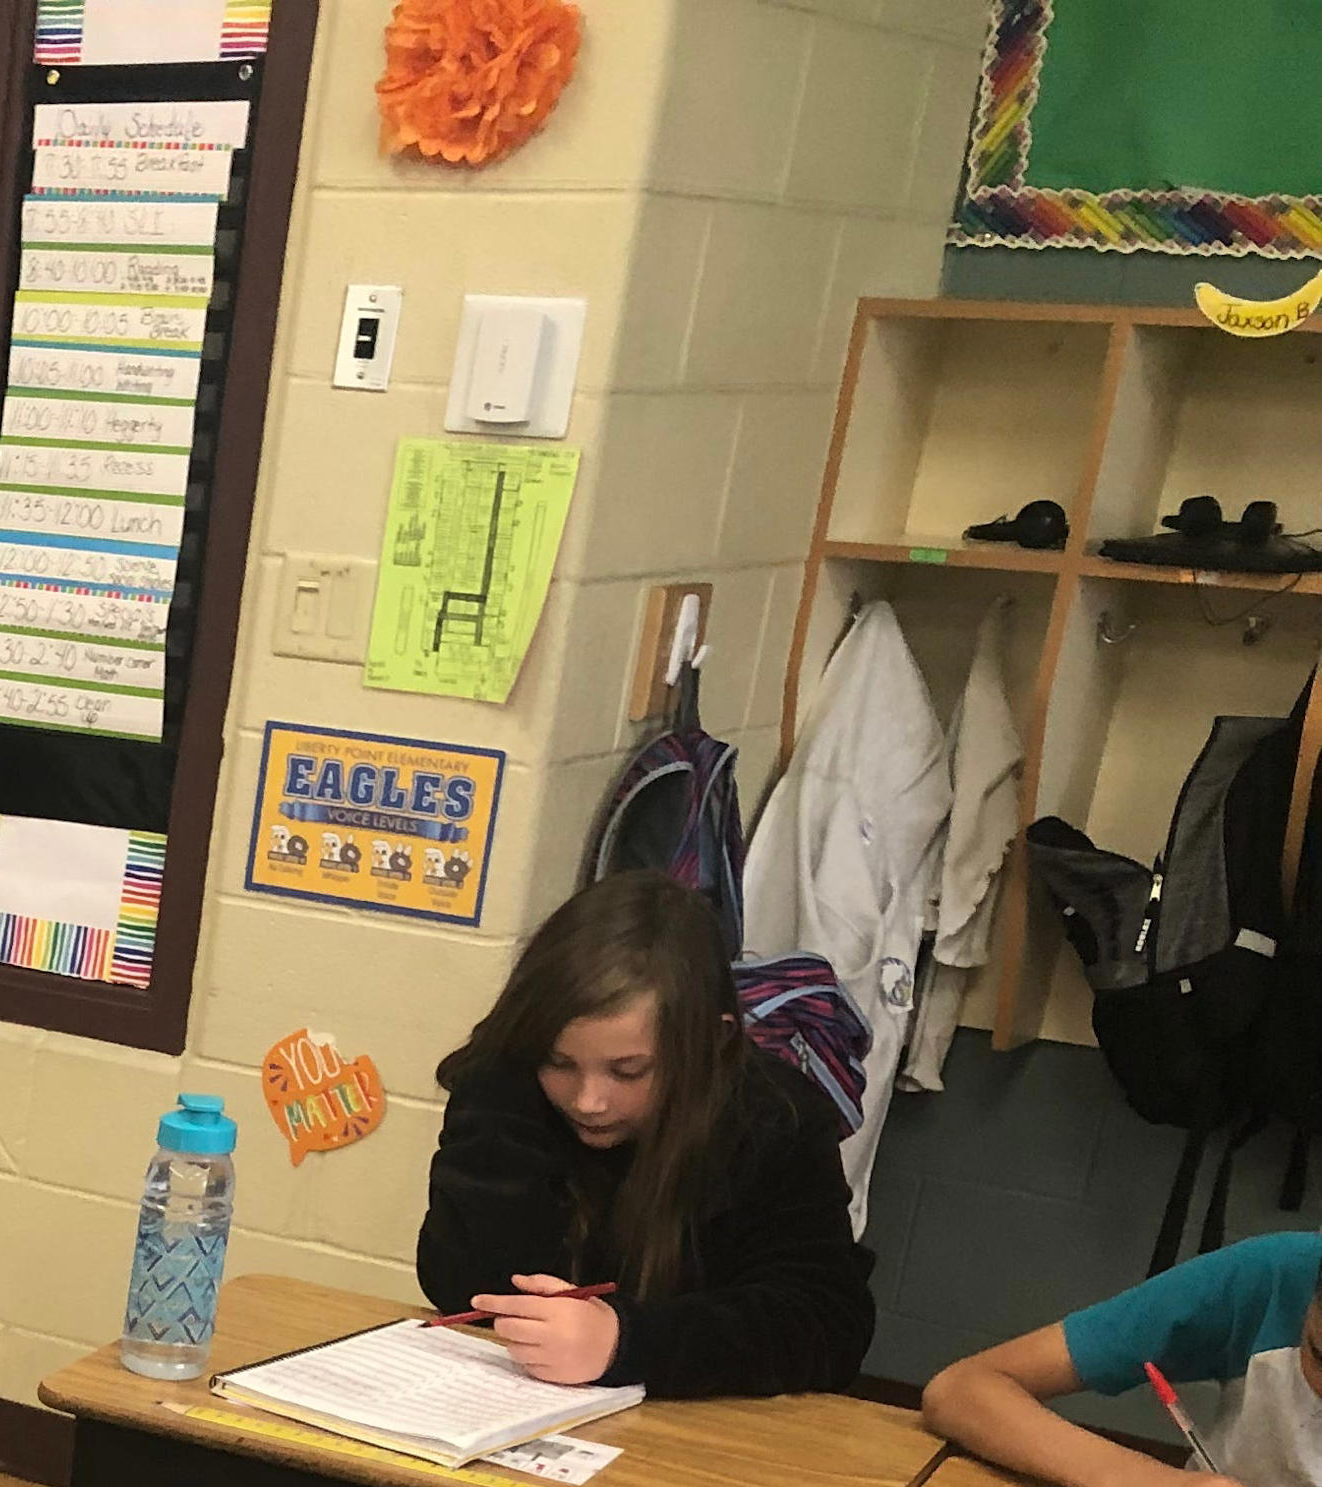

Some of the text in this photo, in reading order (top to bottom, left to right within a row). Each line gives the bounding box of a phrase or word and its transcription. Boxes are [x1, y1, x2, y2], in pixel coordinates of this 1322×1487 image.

[1297, 301, 1310, 321] B
[111, 506, 164, 537] Lunch
[345, 746, 385, 763] POINT
[386, 750, 470, 774] ELEMENTARY
[284, 753, 476, 822] EAGLES
[327, 808, 420, 834] VOICE LEVELS
[279, 1037, 347, 1090] YOU
[284, 1071, 378, 1142] MATTER
